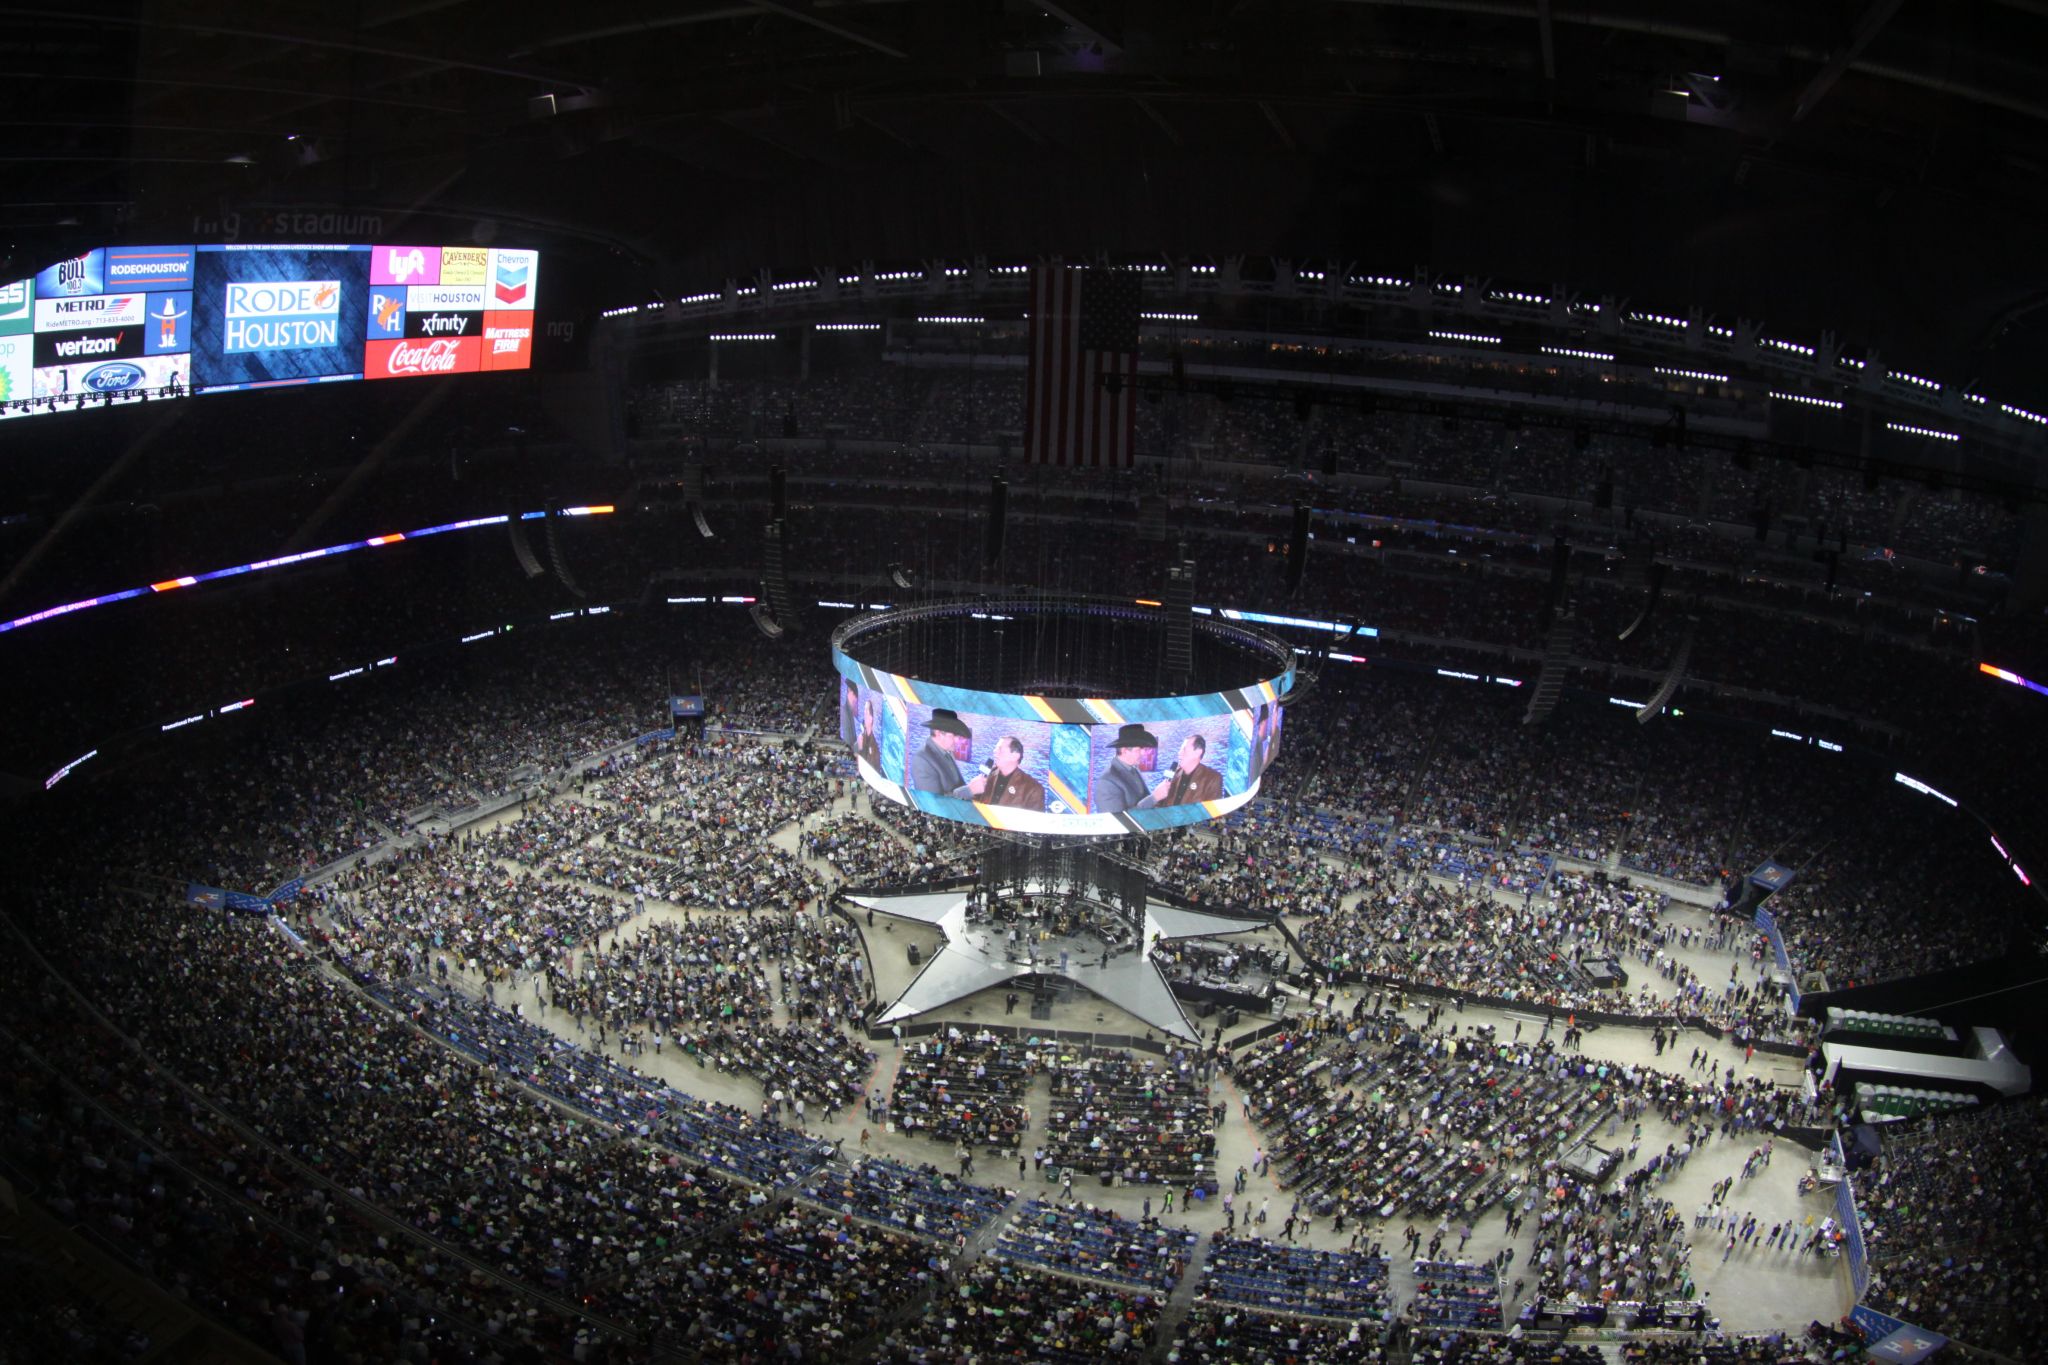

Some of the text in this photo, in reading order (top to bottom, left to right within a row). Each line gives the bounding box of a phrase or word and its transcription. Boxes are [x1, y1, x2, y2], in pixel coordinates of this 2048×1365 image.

[273, 209, 382, 236] stadium
[389, 248, 425, 283] lyft
[442, 251, 487, 267] CAVENDER'S
[497, 253, 529, 264] Chevron
[59, 260, 85, 286] BULL
[111, 263, 187, 276] RODEOHOUSTON
[56, 300, 105, 313] METRO
[433, 293, 481, 303] HOUSTON
[422, 313, 468, 336] xfinity
[485, 327, 530, 339] MATTRESS
[547, 320, 574, 342] nrg
[226, 320, 336, 350] HOUSTON
[56, 336, 116, 356] verizon
[494, 339, 521, 351] FIRM
[97, 369, 131, 388] Ford
